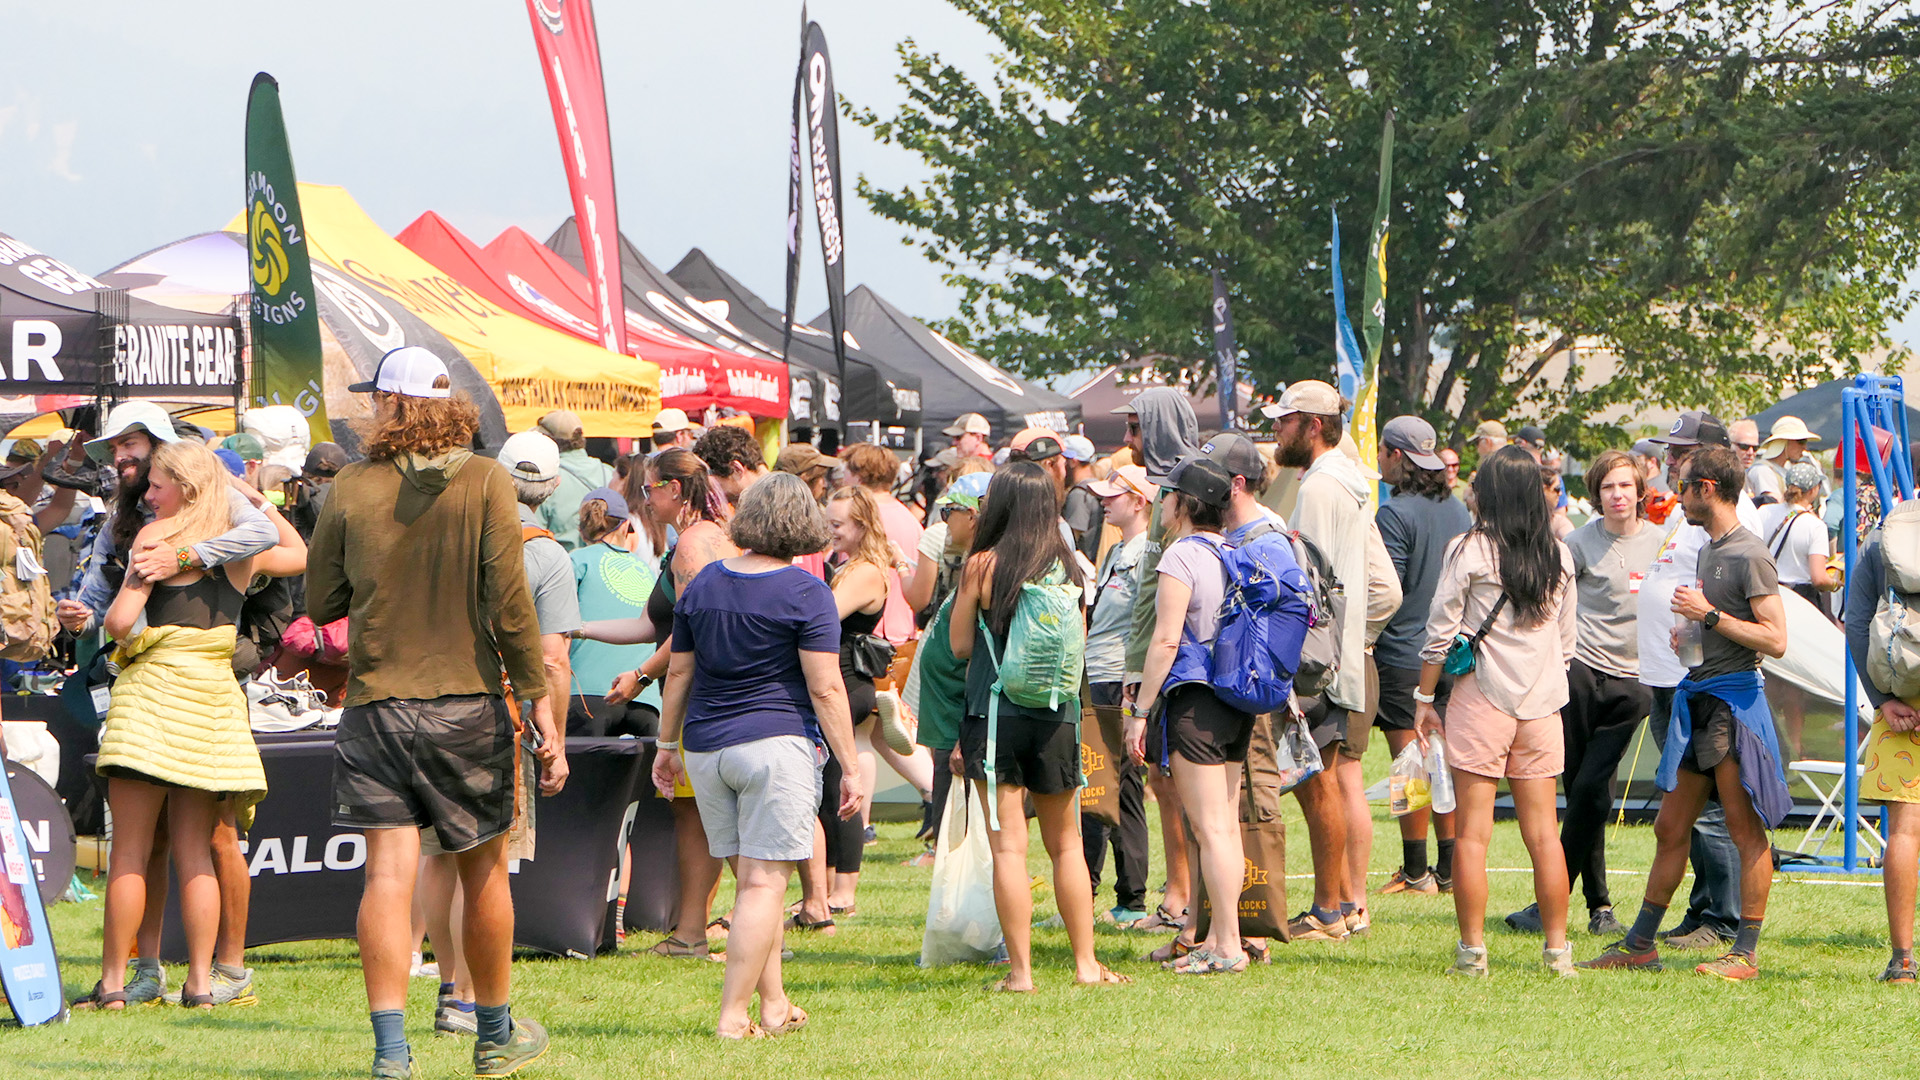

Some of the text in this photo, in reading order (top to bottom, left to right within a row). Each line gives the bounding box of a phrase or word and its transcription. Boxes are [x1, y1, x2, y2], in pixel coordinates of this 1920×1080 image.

[257, 171, 302, 245] MOON
[0, 319, 65, 382] R
[113, 323, 237, 387] GRANITE GEAR
[1081, 785, 1106, 799] LOCKS
[1239, 900, 1267, 910] LOCKS
